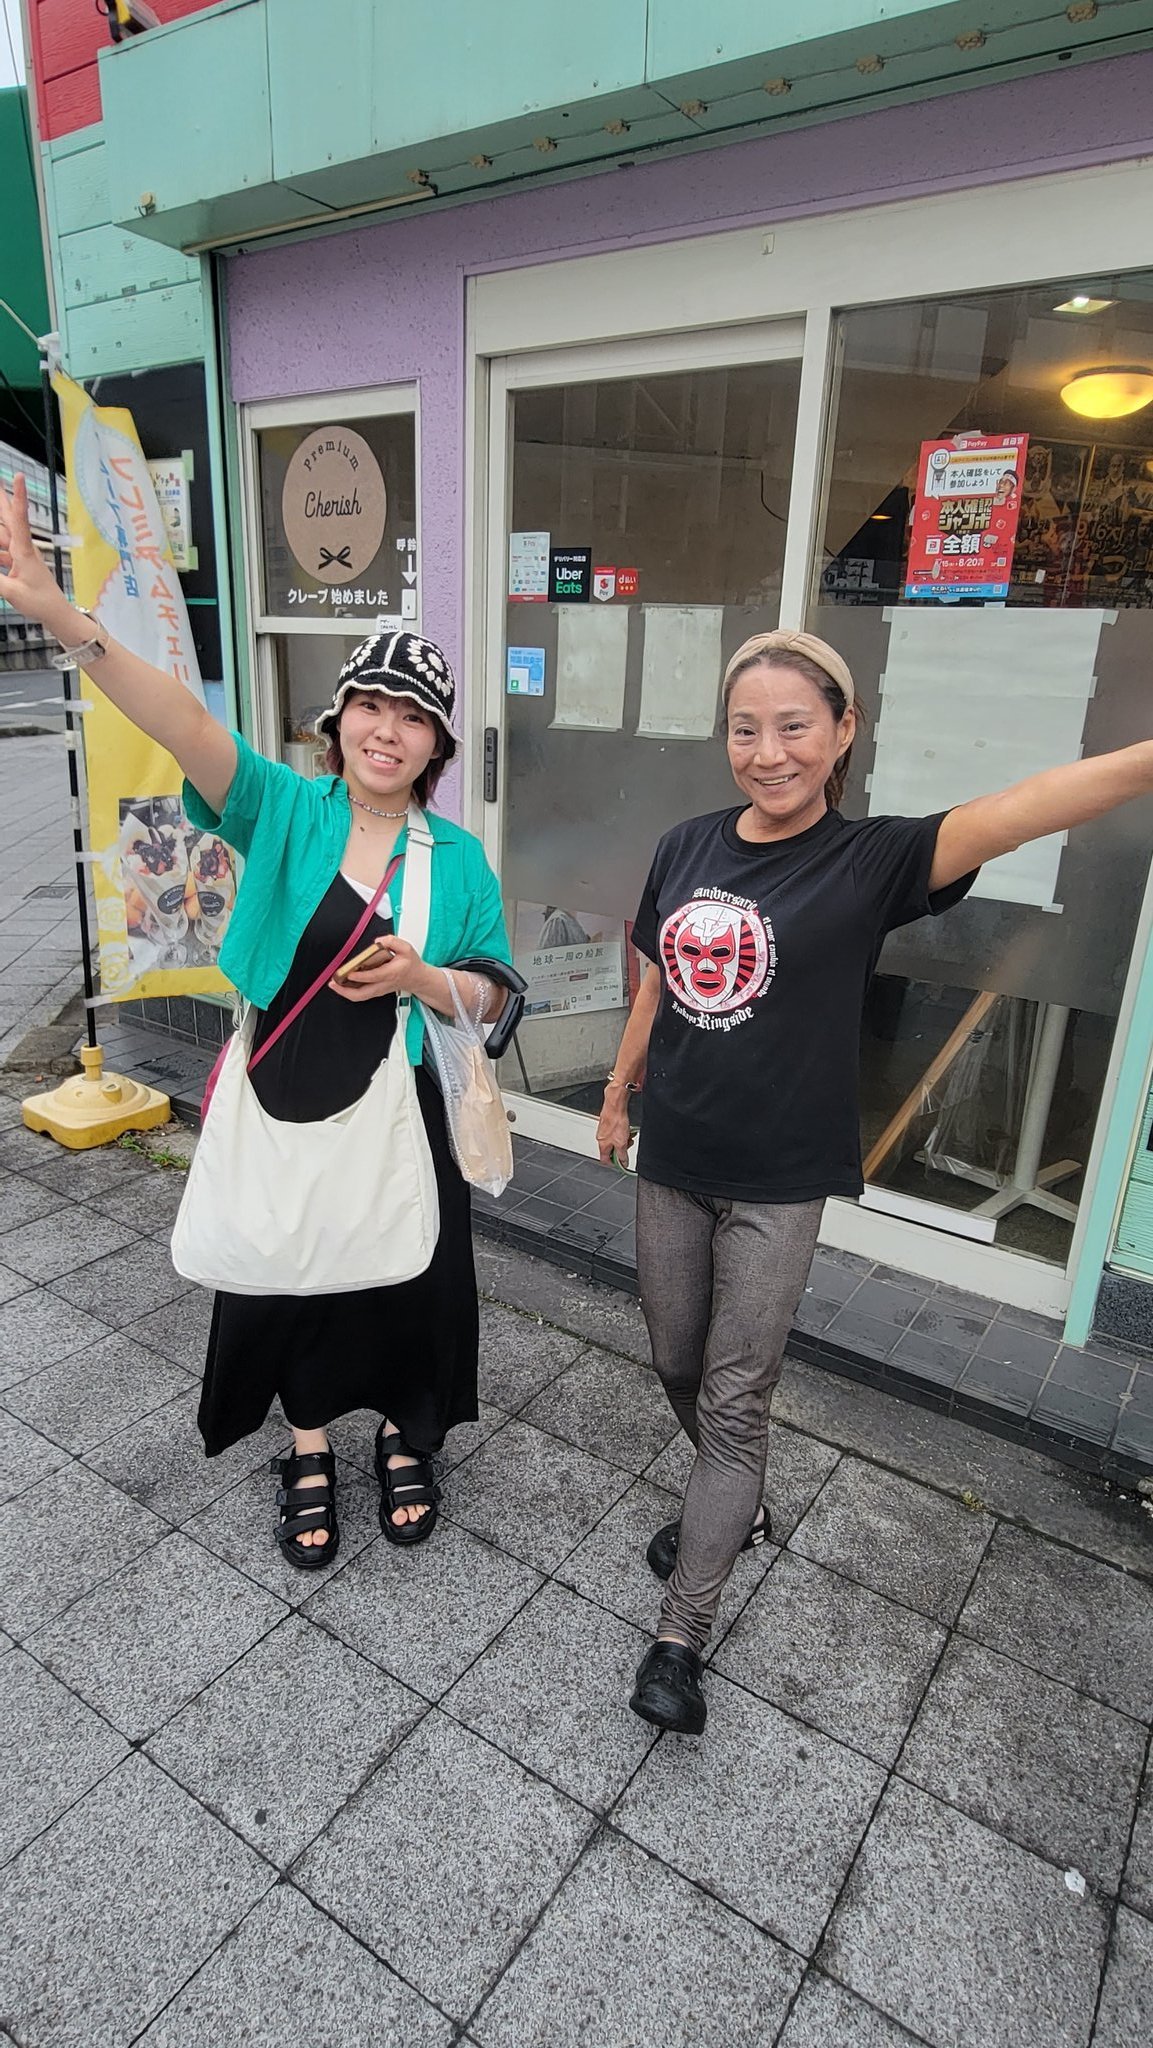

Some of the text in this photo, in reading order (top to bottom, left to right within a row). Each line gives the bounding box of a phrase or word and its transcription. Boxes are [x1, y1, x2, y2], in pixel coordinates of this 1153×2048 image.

[303, 439, 361, 472] Premium
[950, 468, 1002, 479] 本人確認をして
[304, 488, 362, 518] Cherish
[940, 497, 993, 514] 本人確認
[938, 513, 992, 530] ジャンボ
[396, 538, 417, 551] 呼鈴
[942, 533, 982, 554] 全額
[556, 567, 583, 580] Uber
[618, 574, 637, 583] d払い
[288, 588, 389, 605] クレープ 始めました
[555, 582, 582, 594] Eats
[765, 924, 775, 942] amor
[532, 947, 604, 966] 地球一周の船旅
[695, 1005, 755, 1033] Ringside
